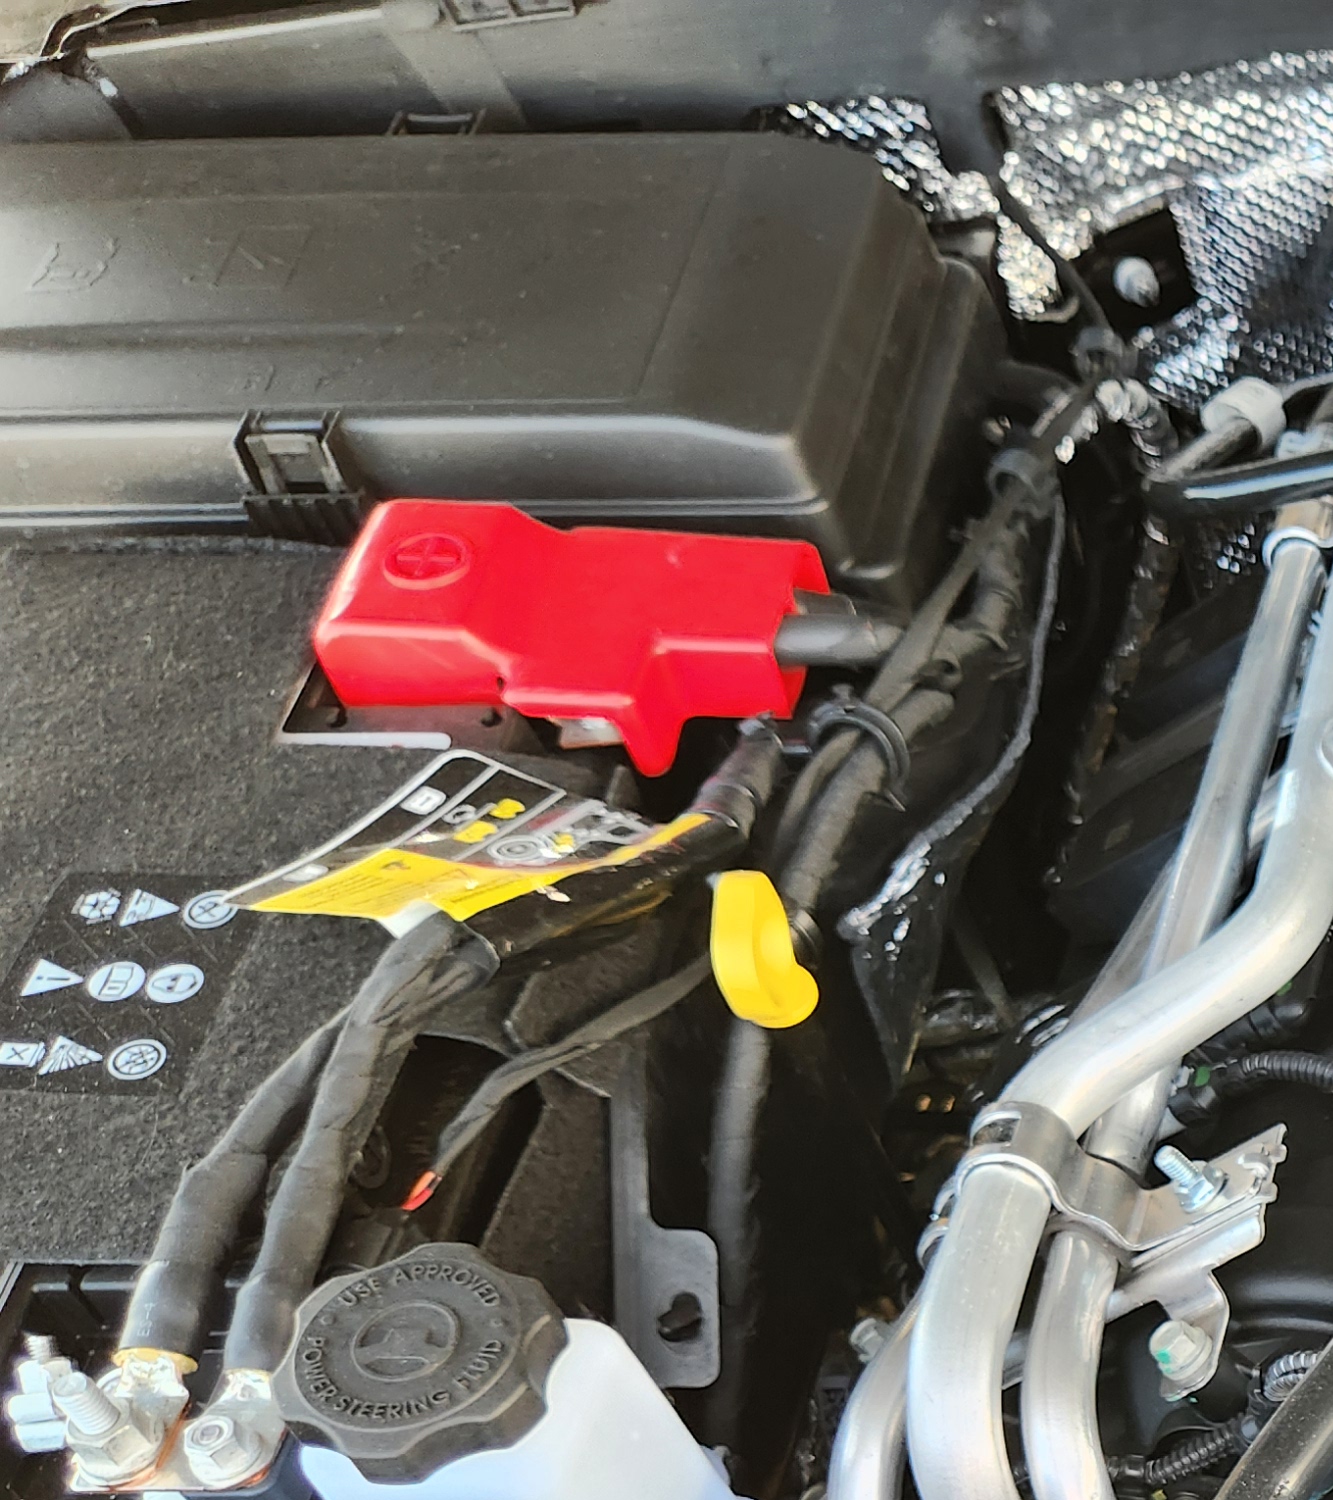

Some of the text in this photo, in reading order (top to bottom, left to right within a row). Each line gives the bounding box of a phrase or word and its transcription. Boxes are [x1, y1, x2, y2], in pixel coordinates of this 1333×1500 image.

[338, 1264, 501, 1307] USE APPROVED
[302, 1336, 503, 1420] POWER STEERING FLUID
